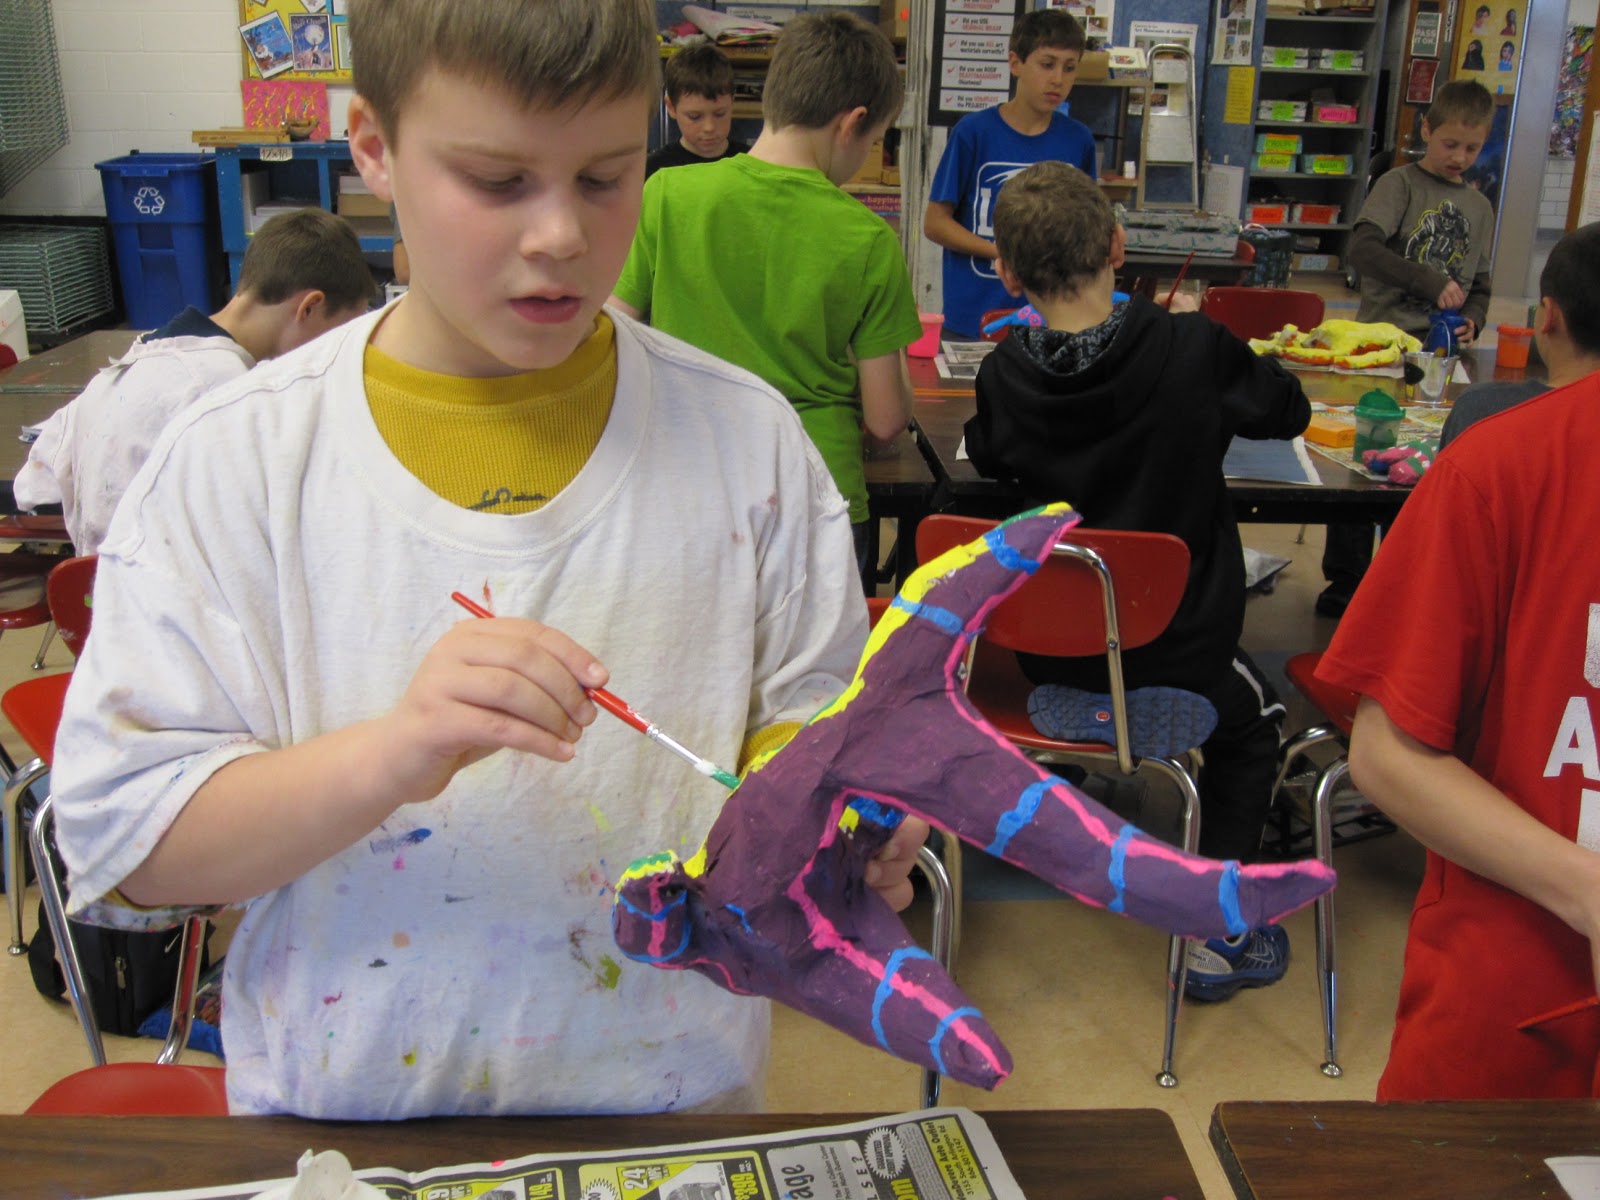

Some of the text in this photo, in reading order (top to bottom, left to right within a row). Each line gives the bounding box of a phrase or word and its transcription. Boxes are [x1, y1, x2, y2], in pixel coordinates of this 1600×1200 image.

[1415, 29, 1436, 37] PASS
[925, 1121, 941, 1144] Outlet
[873, 1140, 886, 1170] GUARANTEED
[937, 1145, 948, 1162] Auto
[944, 1134, 958, 1160] Arlington
[622, 1167, 649, 1190] 24
[955, 1161, 966, 1179] South
